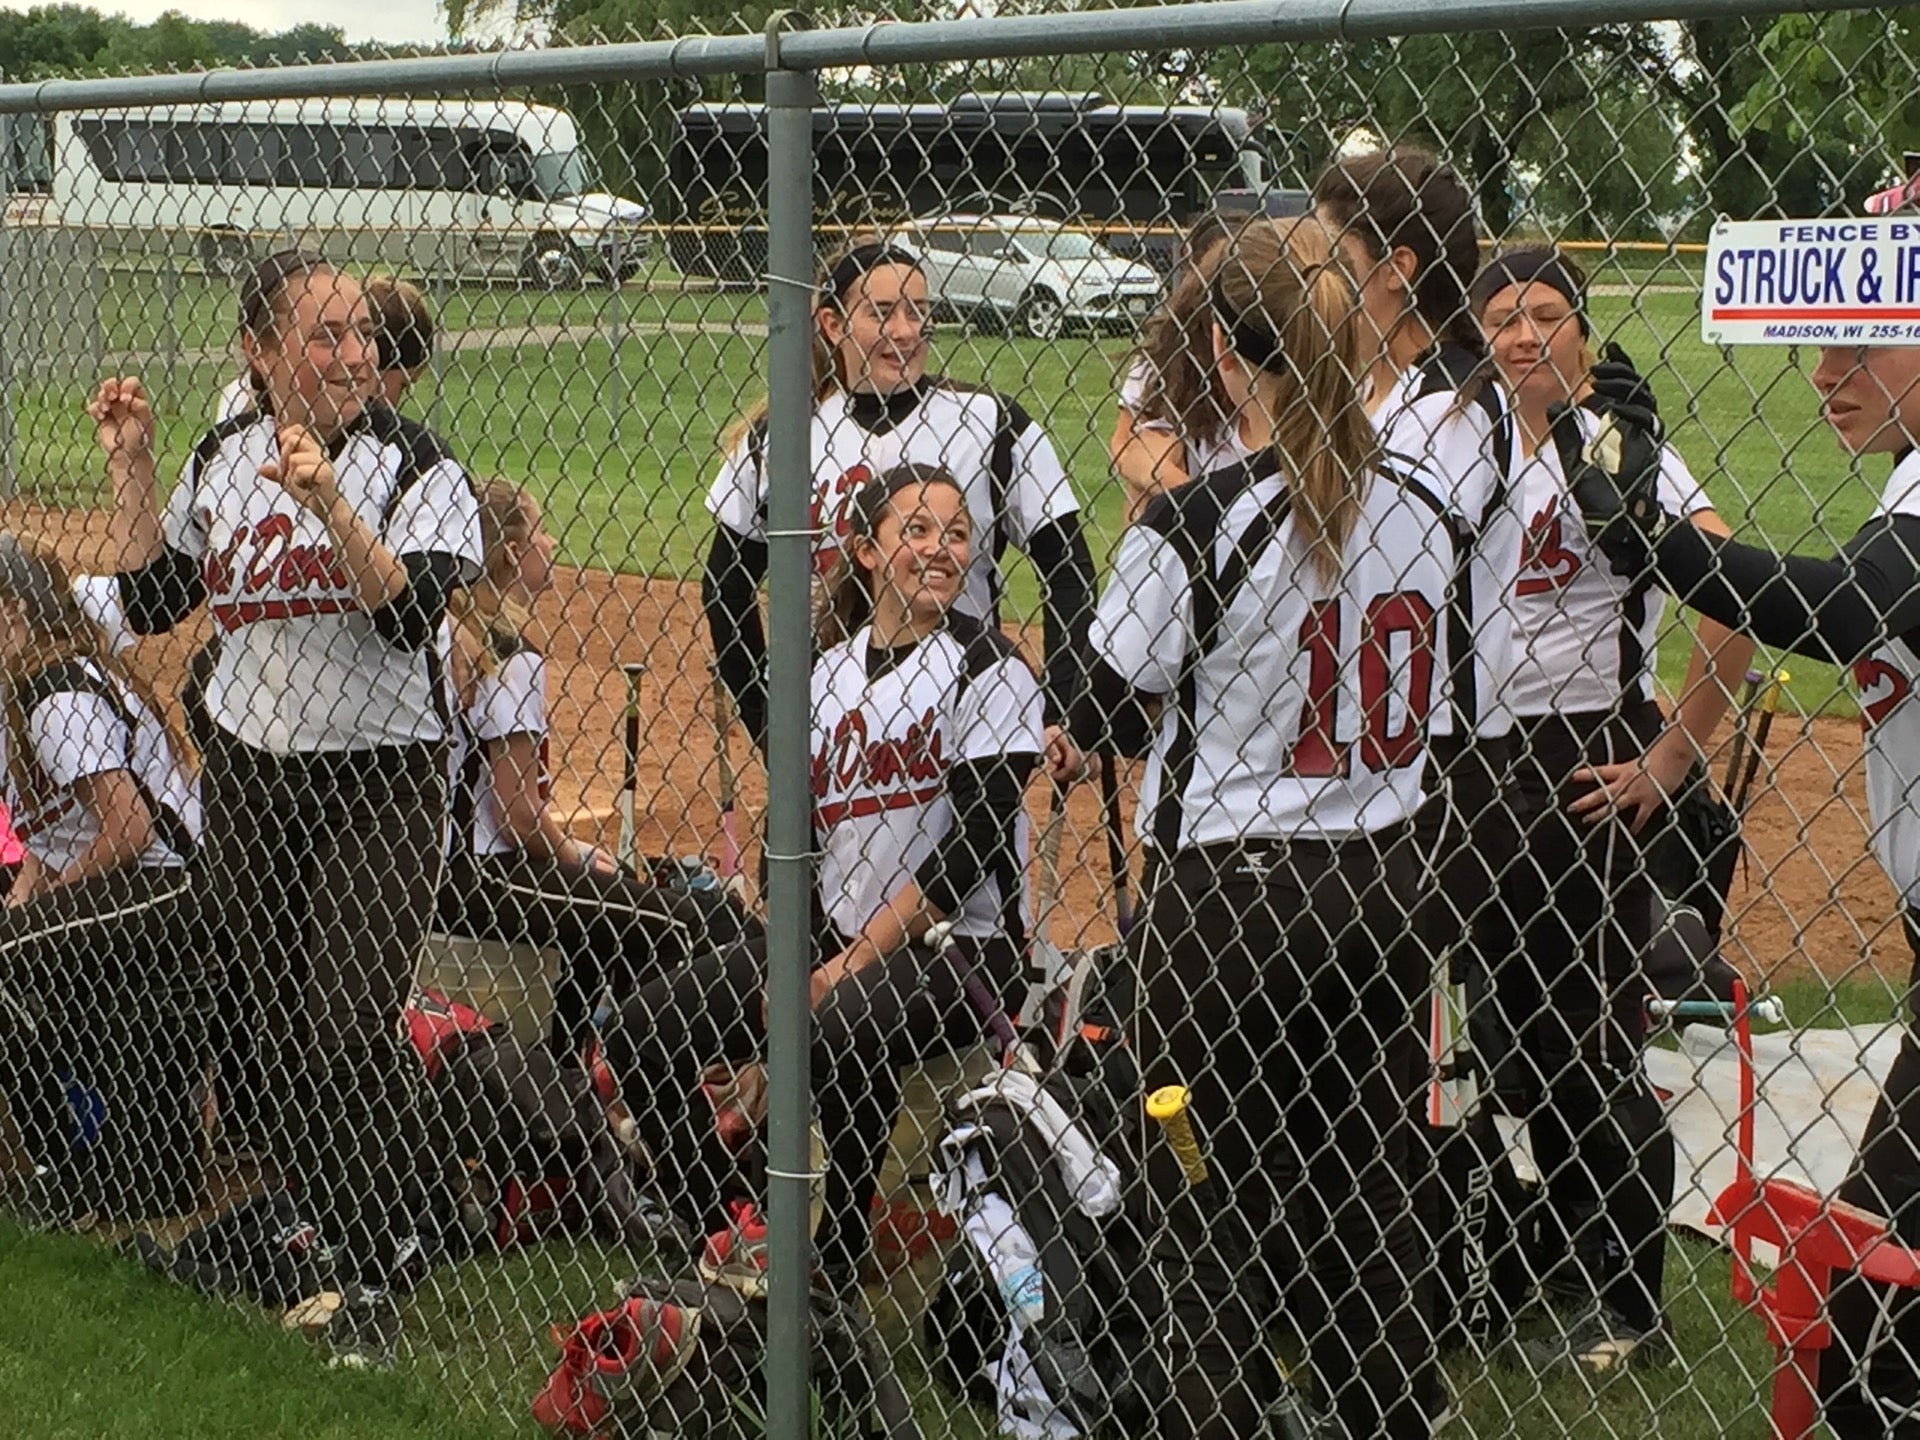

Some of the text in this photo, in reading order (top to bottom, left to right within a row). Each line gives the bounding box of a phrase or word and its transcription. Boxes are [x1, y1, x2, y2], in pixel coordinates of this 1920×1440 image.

[1780, 225, 1878, 242] FENCE
[1715, 247, 1846, 305] STRUCK
[1856, 247, 1882, 304] &
[1764, 325, 1838, 340] MADISON,
[1843, 325, 1863, 338] WI
[1281, 589, 1437, 779] 10
